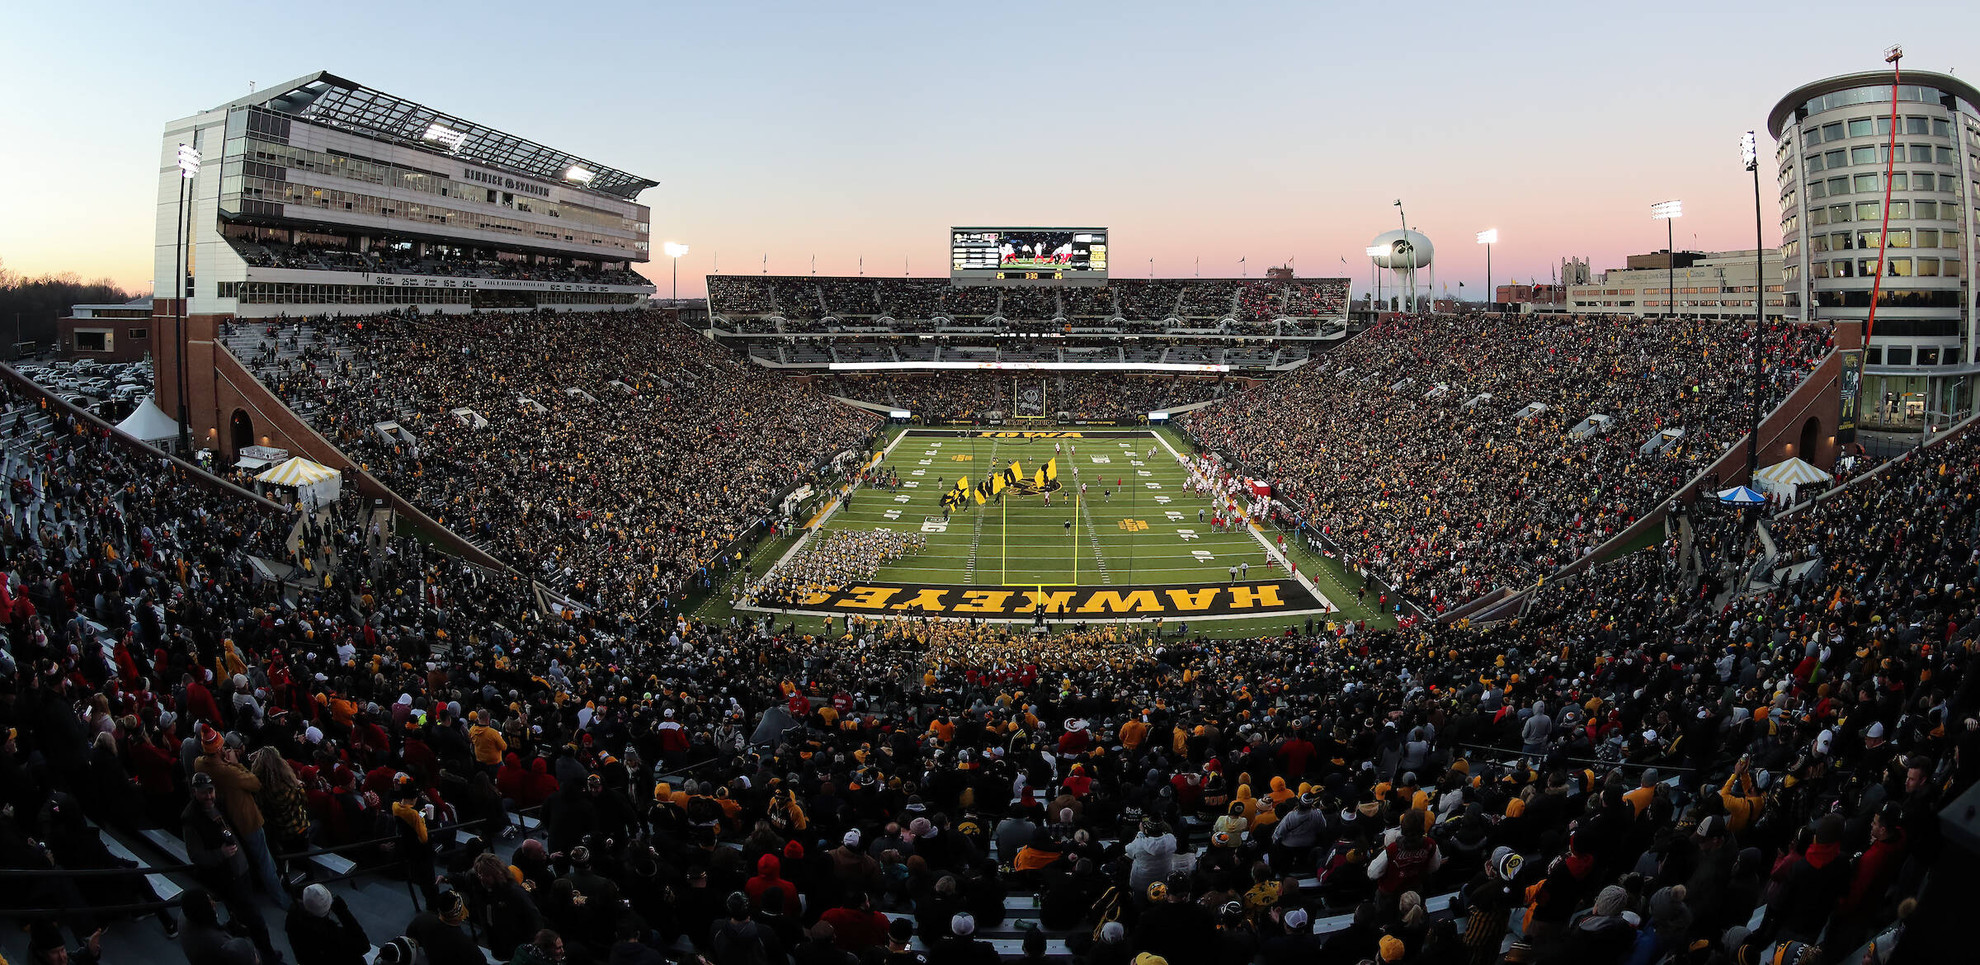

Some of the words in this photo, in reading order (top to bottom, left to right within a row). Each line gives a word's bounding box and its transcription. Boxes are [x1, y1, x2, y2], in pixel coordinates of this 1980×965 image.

[465, 168, 503, 186] KINNICK
[515, 180, 550, 197] STADIUM
[376, 276, 385, 285] 36
[402, 278, 410, 286] 25
[977, 431, 1084, 439] IOWA
[1790, 649, 1797, 662] 9
[1125, 806, 1143, 815] Back
